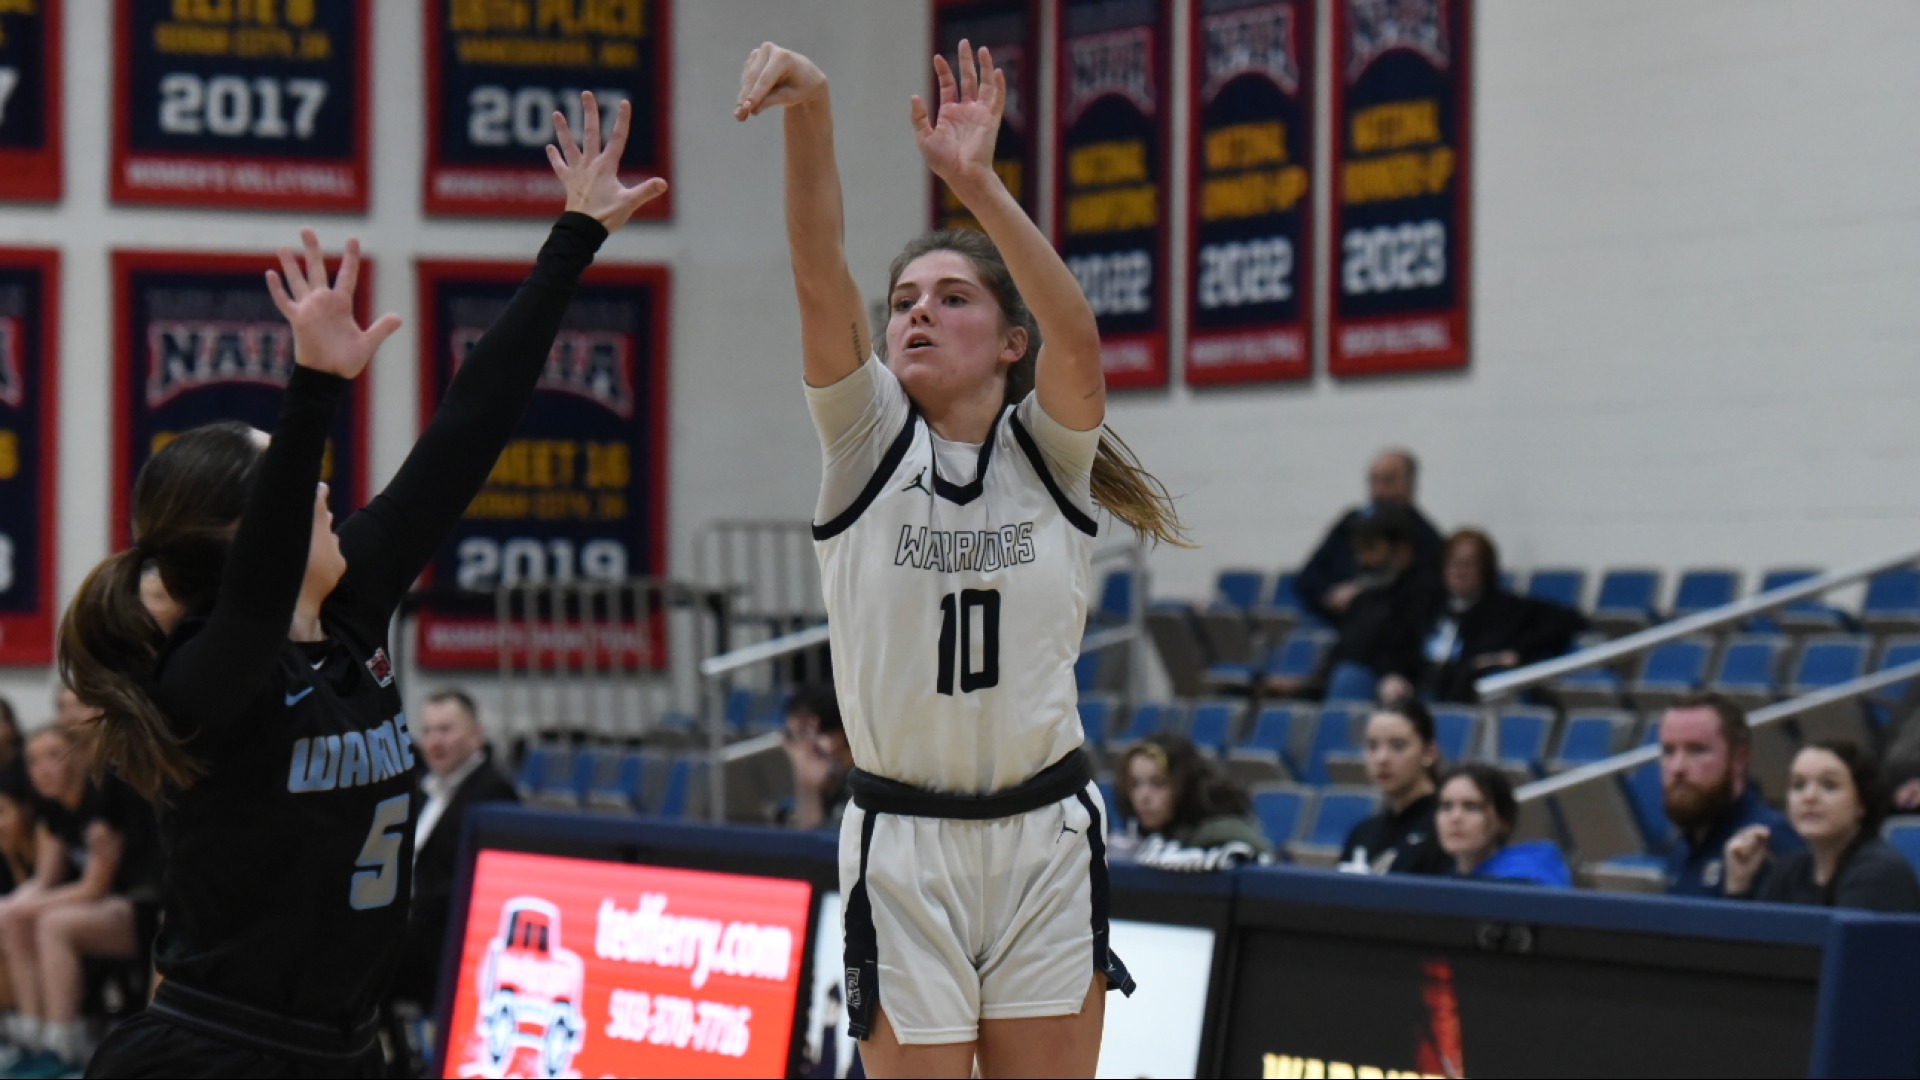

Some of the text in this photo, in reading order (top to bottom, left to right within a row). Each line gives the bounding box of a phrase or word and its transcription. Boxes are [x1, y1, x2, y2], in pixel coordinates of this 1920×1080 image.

[159, 72, 328, 140] 2017
[468, 86, 631, 148] 2017
[1197, 235, 1294, 308] 2022
[1342, 218, 1448, 295] 2023
[150, 322, 293, 402] NAI
[457, 537, 628, 593] 2019
[894, 521, 1036, 574] WARRIORS
[937, 588, 1001, 696] 10
[349, 792, 411, 911] 5
